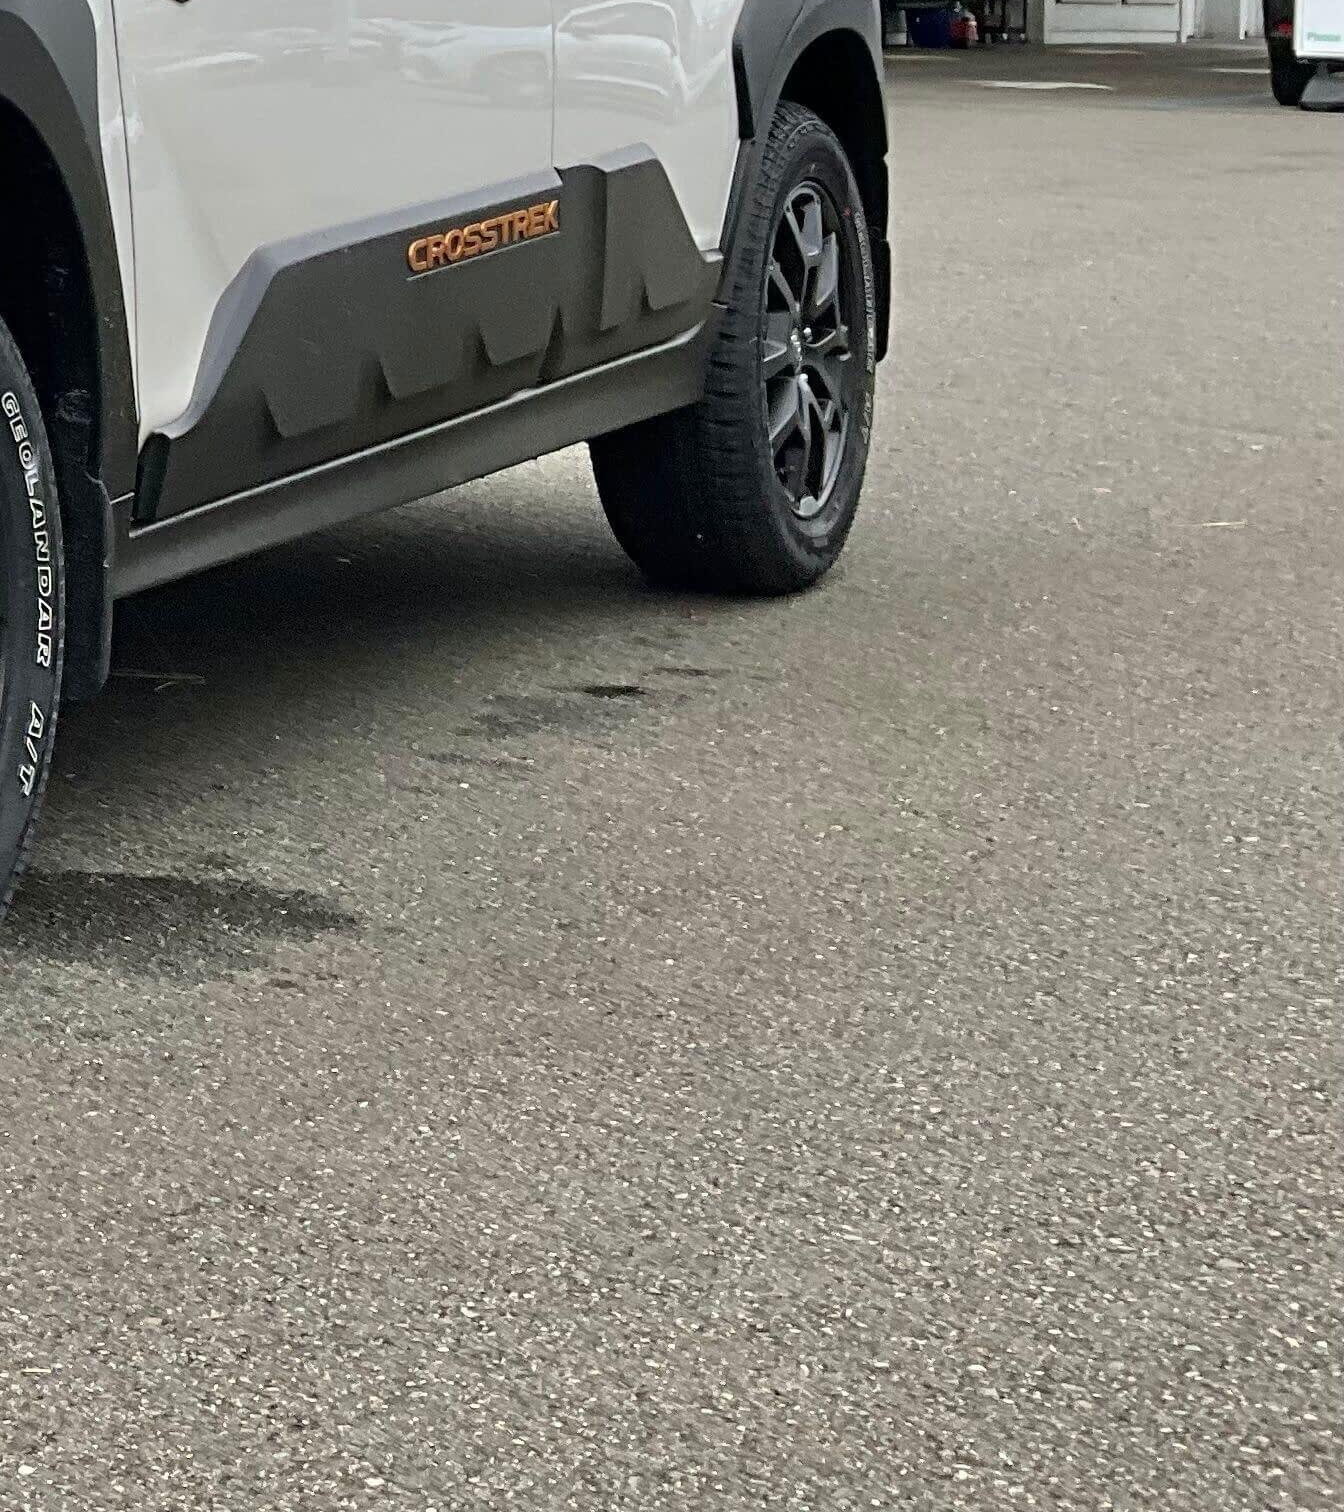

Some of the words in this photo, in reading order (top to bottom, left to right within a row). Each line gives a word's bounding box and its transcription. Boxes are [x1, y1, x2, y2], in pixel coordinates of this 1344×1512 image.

[408, 199, 560, 272] CROSSTREK
[1, 391, 53, 668] GEOLANDAR
[18, 700, 45, 797] A/T
